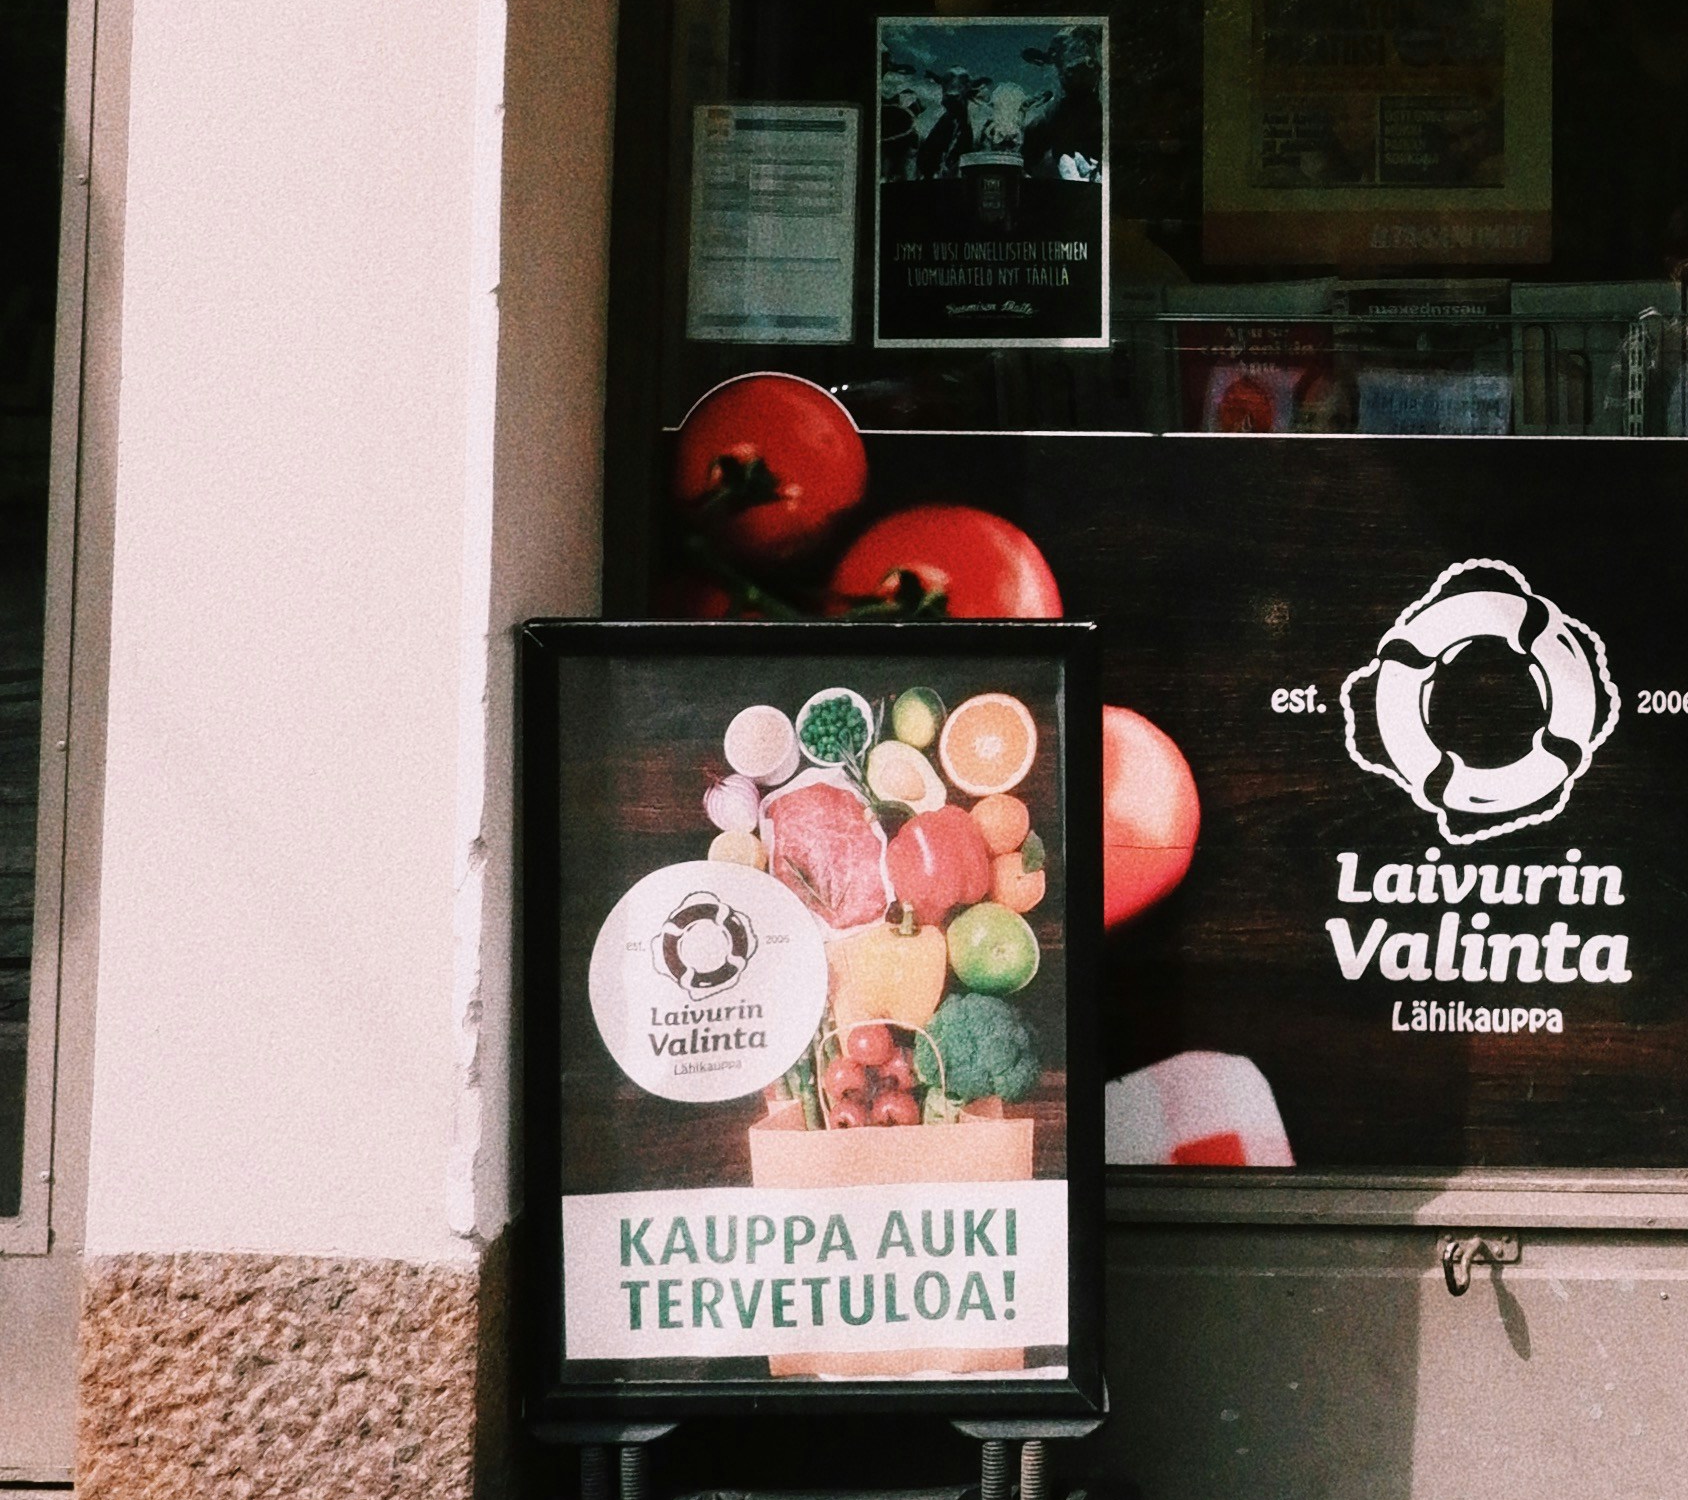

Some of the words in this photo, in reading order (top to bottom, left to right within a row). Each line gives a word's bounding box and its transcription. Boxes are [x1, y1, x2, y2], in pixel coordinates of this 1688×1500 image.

[932, 241, 960, 262] UUSI
[963, 240, 1038, 262] ONNELLISTEN
[1041, 240, 1088, 262] LEHMIEN
[997, 265, 1020, 286] NYT
[1270, 684, 1328, 714] est.
[1335, 846, 1627, 906] Laivurin
[1324, 911, 1634, 985] Valinta
[650, 999, 765, 1027] Laivurin
[1391, 1000, 1565, 1035] Lähikauppa
[647, 1026, 769, 1058] Valinta
[673, 1059, 743, 1077] Lähikauppa
[619, 1212, 859, 1268] KAUPPA
[876, 1207, 1019, 1261] AUKI
[619, 1269, 1018, 1332] TERVETULOA!
